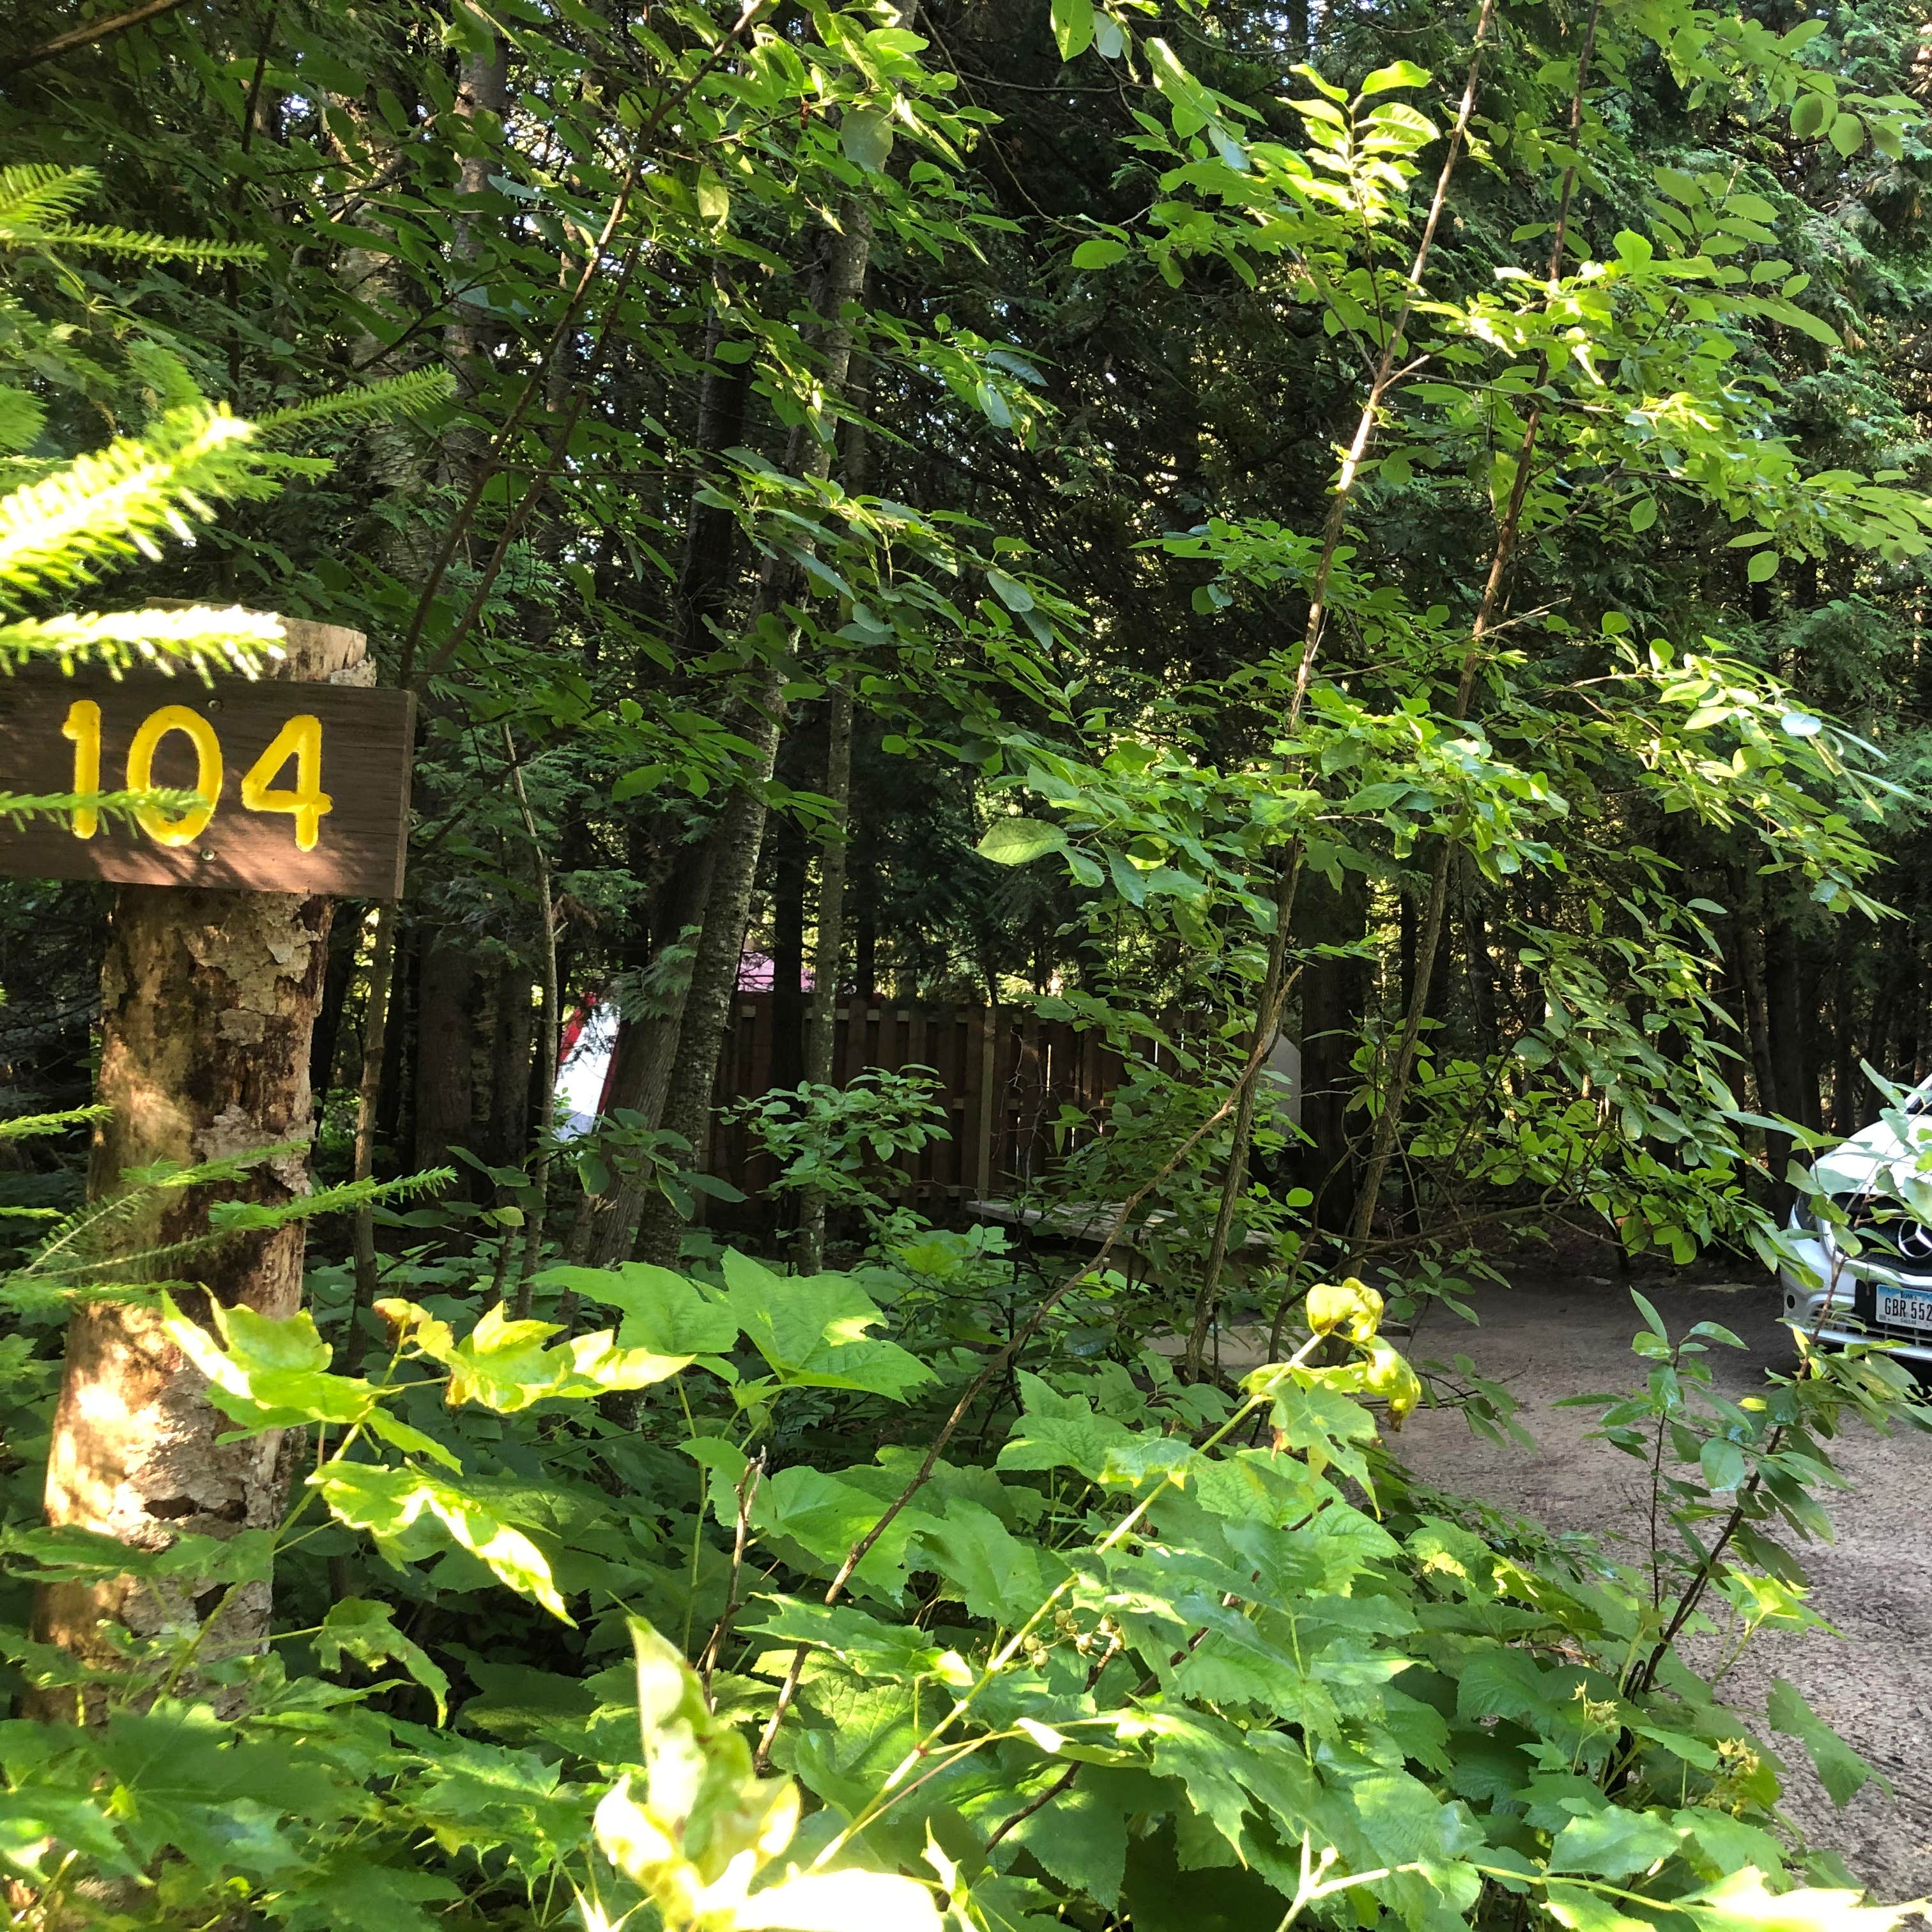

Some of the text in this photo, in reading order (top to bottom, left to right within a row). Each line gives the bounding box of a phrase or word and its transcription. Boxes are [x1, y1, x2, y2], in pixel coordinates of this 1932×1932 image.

[62, 700, 333, 852] 104
[1885, 1297, 1932, 1321] GBR 552
